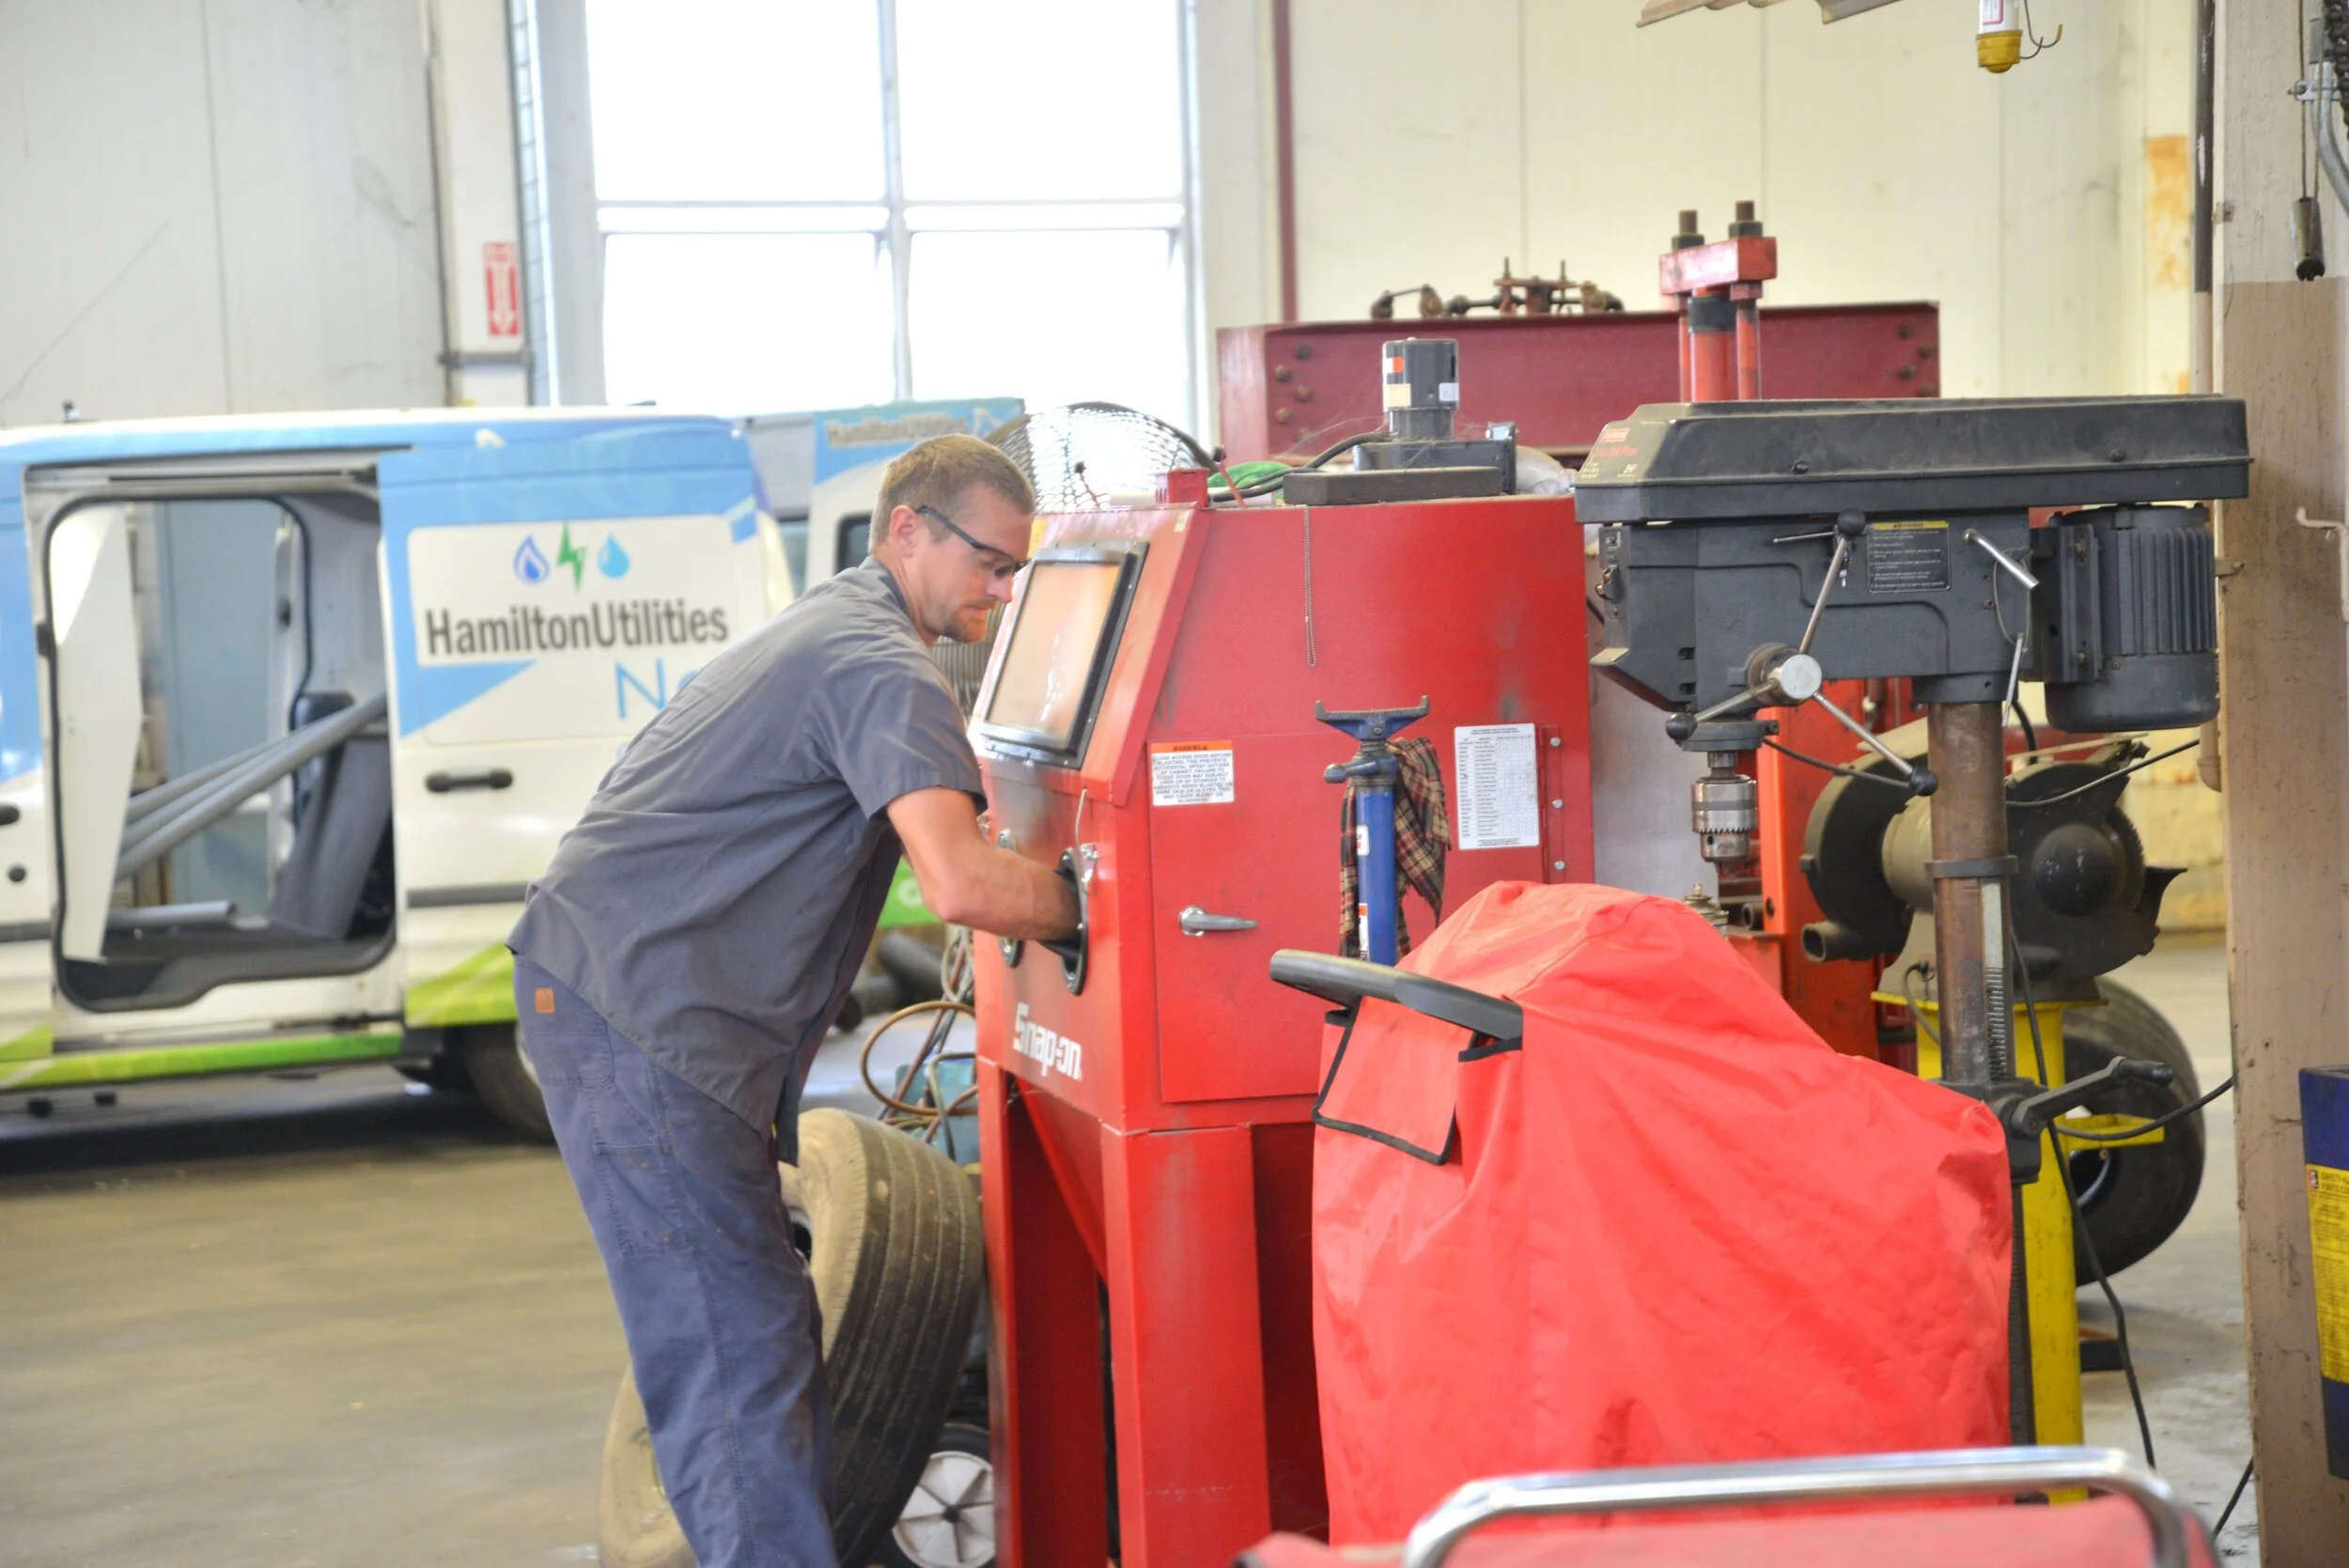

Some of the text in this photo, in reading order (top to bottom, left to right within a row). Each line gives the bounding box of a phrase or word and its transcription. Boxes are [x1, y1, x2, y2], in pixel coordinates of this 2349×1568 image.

[425, 598, 729, 656] HamiltonUtilities
[614, 657, 698, 721] N
[1012, 1001, 1082, 1081] Snap-on
